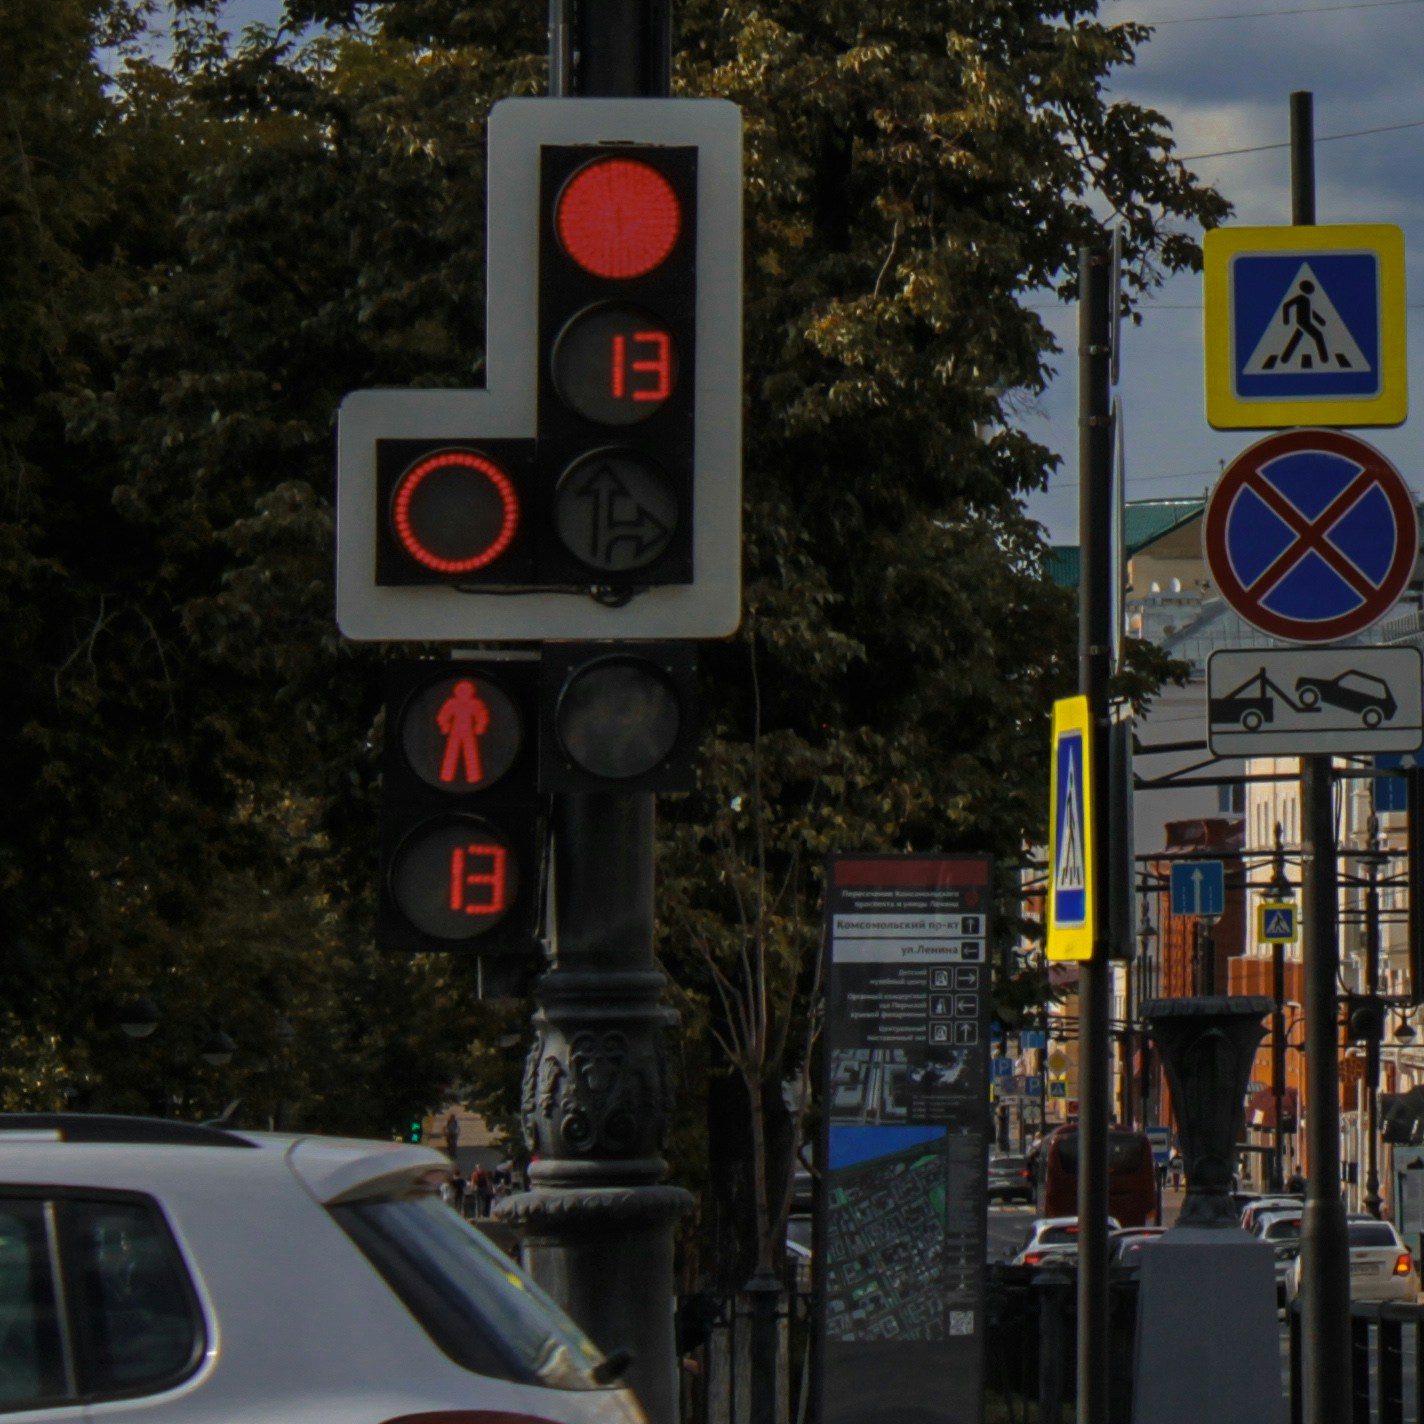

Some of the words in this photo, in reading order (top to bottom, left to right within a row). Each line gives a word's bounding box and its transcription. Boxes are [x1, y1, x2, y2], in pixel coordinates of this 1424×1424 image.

[612, 331, 670, 401] 13
[450, 844, 506, 914] 13
[837, 919, 926, 930] Комсомольский
[928, 922, 959, 931] пр-кт
[901, 944, 958, 956] ул.Ленина
